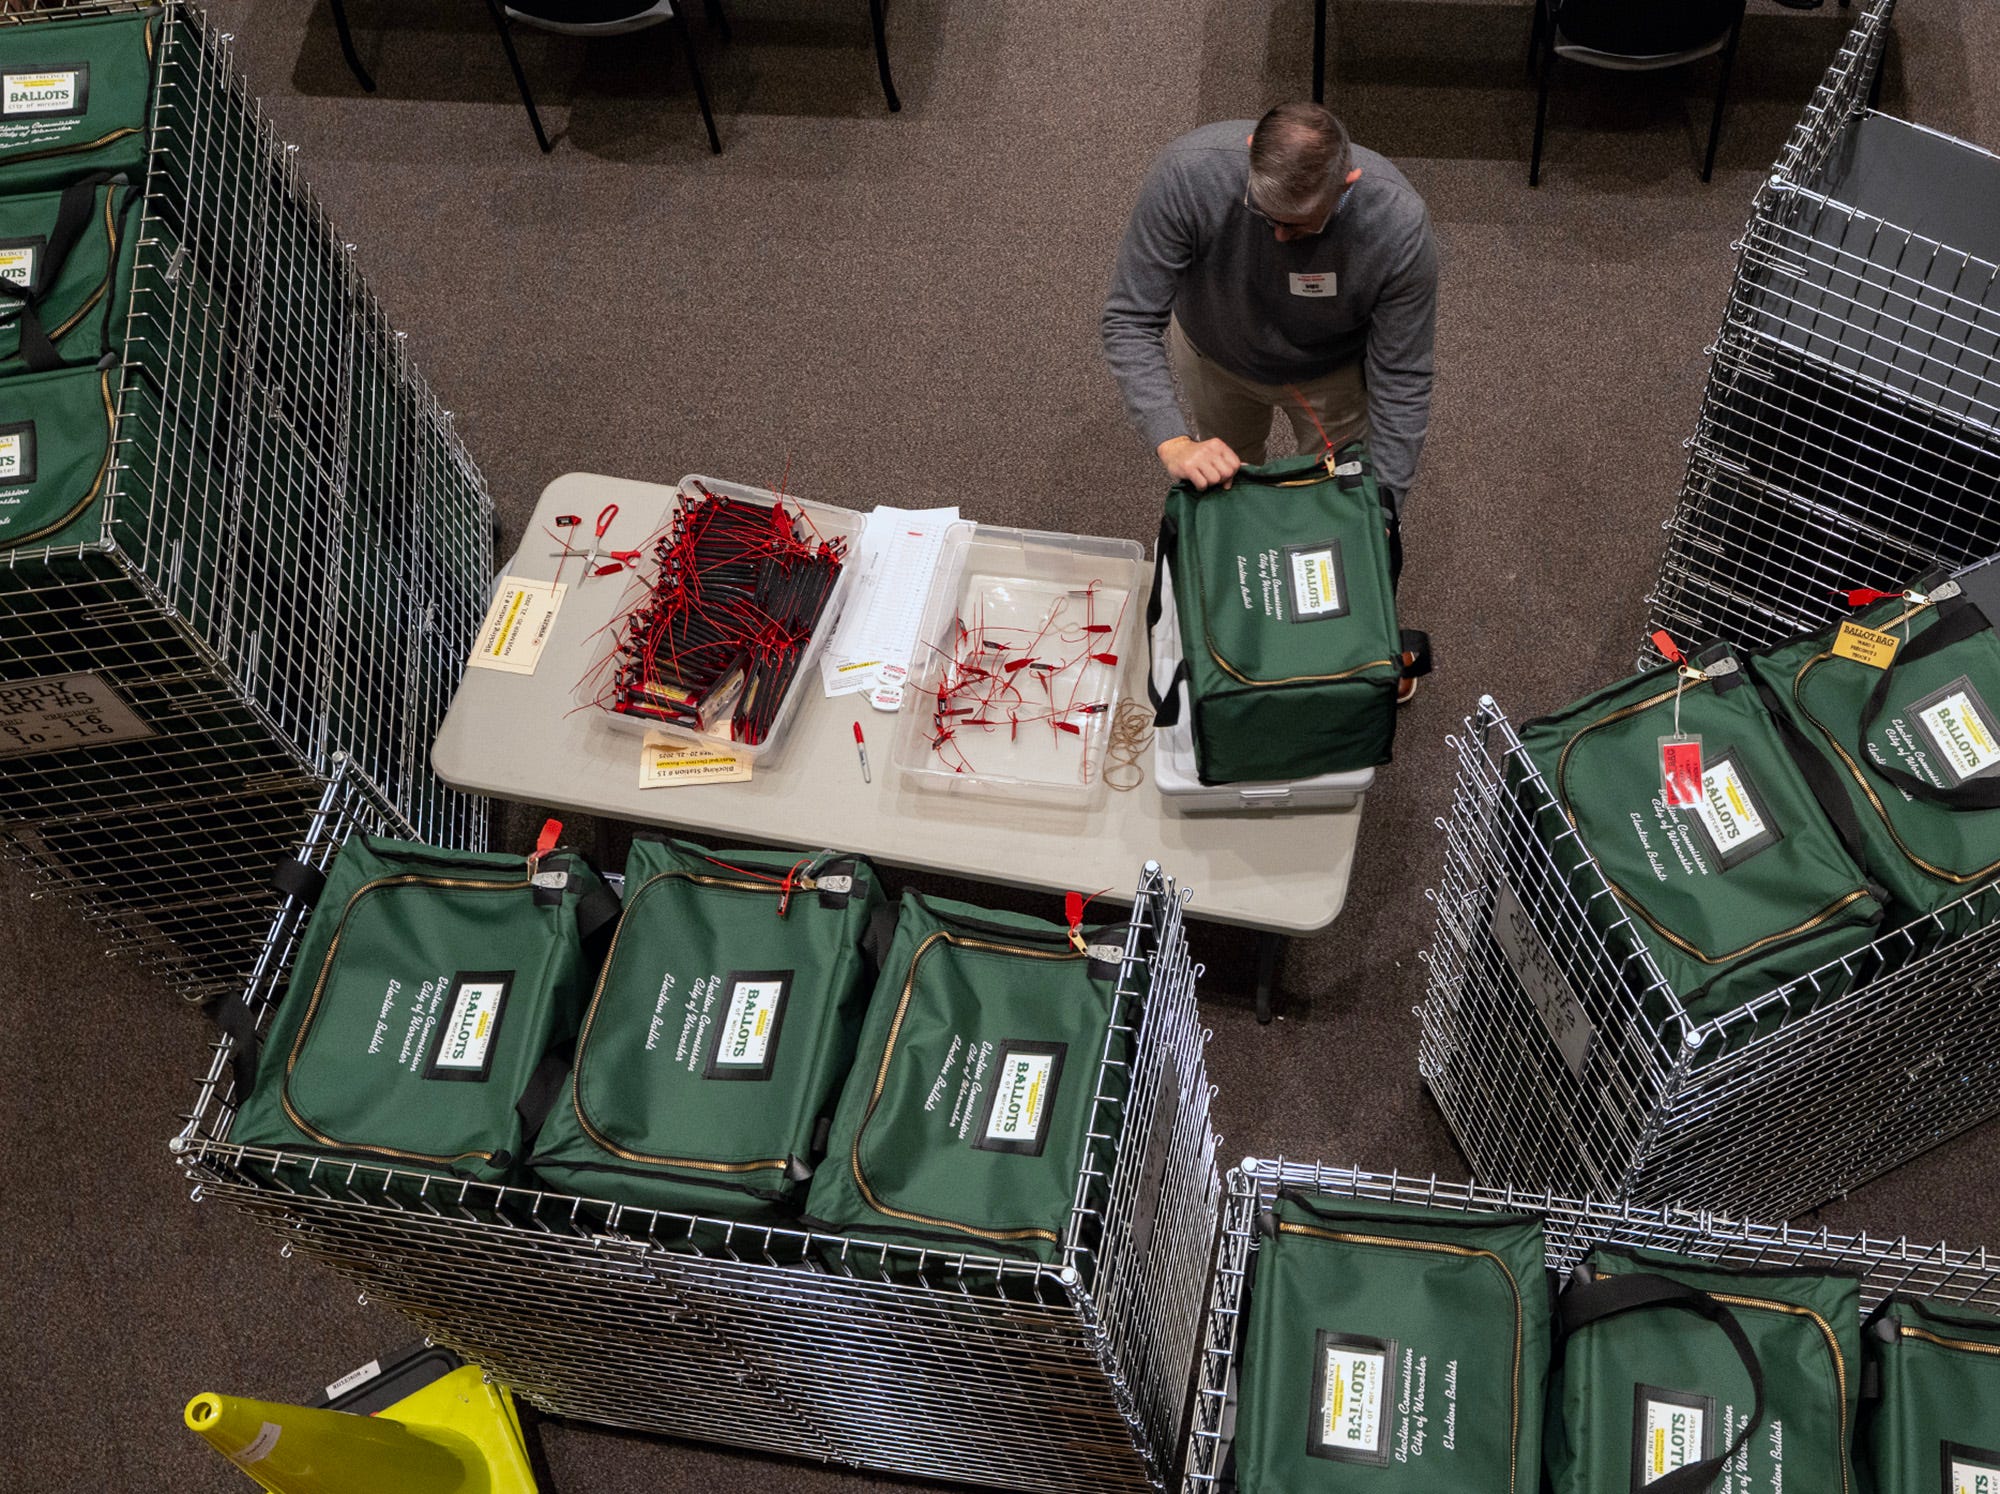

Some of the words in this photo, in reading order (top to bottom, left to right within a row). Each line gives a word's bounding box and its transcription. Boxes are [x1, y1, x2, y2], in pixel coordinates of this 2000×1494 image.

[10, 90, 69, 102] BALLOTS
[1305, 560, 1320, 609] BALLOTS
[1844, 626, 1877, 642] BALLOT
[1876, 636, 1895, 647] BAG
[0, 681, 70, 702] PPLY
[52, 692, 94, 708] #5
[4, 726, 20, 736] 9
[14, 734, 46, 745] 10
[1937, 708, 1980, 768] BALLOTS
[675, 768, 701, 776] Station
[1914, 751, 1945, 789] Commissi
[1703, 776, 1741, 840] BALLOTS
[1630, 812, 1651, 850] Election
[1646, 850, 1667, 883] Ballots
[1651, 798, 1664, 821] City
[1660, 819, 1673, 830] of
[1667, 829, 1694, 876] Worcester
[1678, 824, 1709, 877] Commission
[380, 979, 401, 1019] Election
[415, 981, 434, 1003] City
[429, 976, 449, 1014] Election
[656, 973, 675, 1014] Election
[685, 1000, 699, 1013] of
[689, 977, 706, 1000] City
[702, 975, 721, 1013] Election
[411, 1003, 425, 1016] of
[452, 990, 483, 1060] BALLOTS
[733, 988, 760, 1058] BALLOTS
[368, 1020, 388, 1054] Ballots
[399, 1016, 424, 1064] Worcester
[410, 1016, 436, 1072] Commission
[645, 1014, 664, 1050] Ballots
[675, 1013, 698, 1062] Worcester
[688, 1014, 711, 1072] Commission
[941, 1034, 962, 1075] Election
[966, 1043, 978, 1065] City
[975, 1041, 993, 1081] Election
[924, 1075, 948, 1112] Ballots
[958, 1081, 983, 1140] Commission
[1004, 1062, 1029, 1133] BALLOTS
[1348, 1360, 1367, 1441] BALLOTS
[1398, 1348, 1414, 1415] Commission
[1413, 1356, 1427, 1413] Worcester
[1445, 1360, 1458, 1401] Ballots
[1365, 1423, 1374, 1444] City
[1395, 1417, 1409, 1464] Election
[1413, 1414, 1429, 1428] of
[1443, 1402, 1456, 1451] Election
[1671, 1413, 1686, 1467] LLOTS
[1722, 1405, 1734, 1473] Comission
[1769, 1419, 1783, 1461] Ballots
[1411, 1430, 1428, 1456] City
[1735, 1473, 1752, 1487] of
